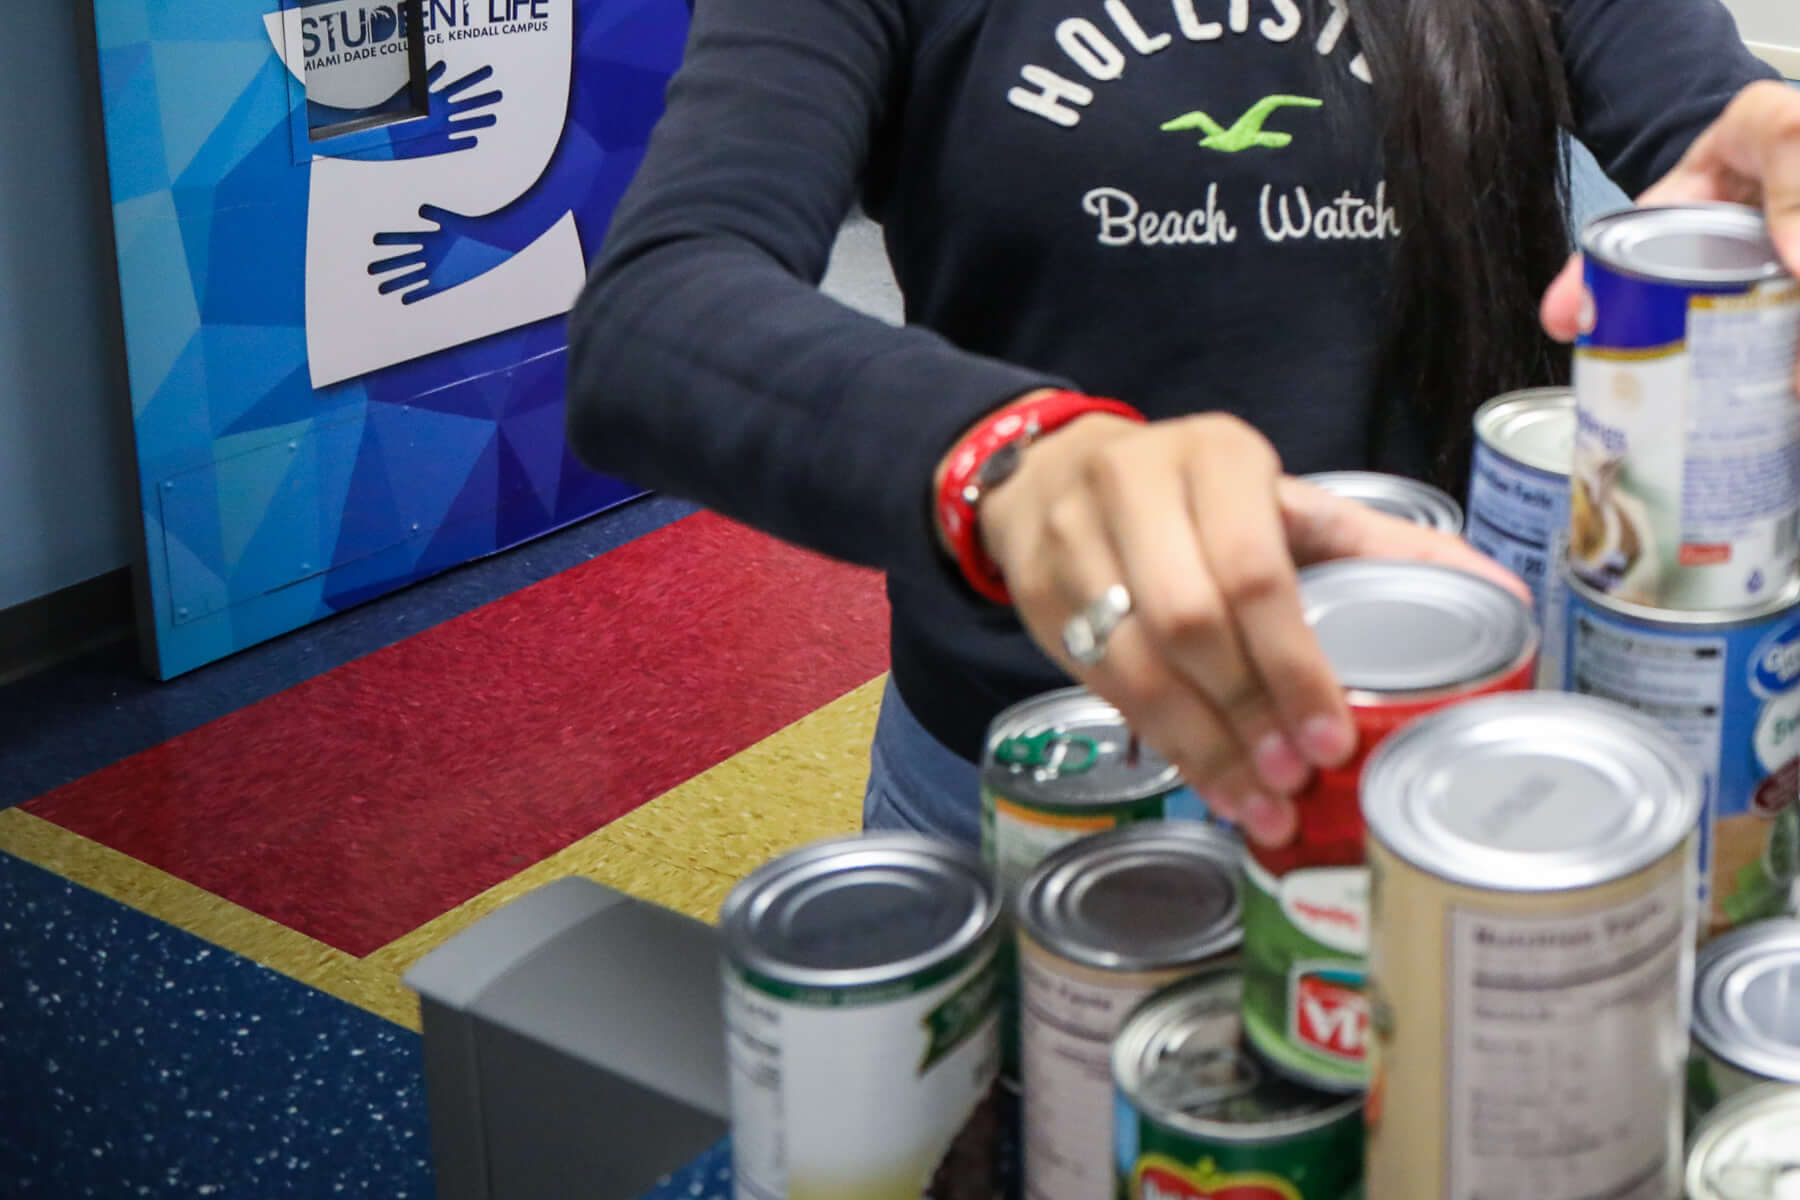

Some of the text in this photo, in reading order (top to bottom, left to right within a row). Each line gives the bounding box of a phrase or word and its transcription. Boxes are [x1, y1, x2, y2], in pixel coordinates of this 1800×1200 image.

[343, 46, 377, 64] DADE
[379, 33, 445, 56] COLLGE,
[448, 25, 500, 43] KENDALL
[501, 21, 549, 35] CAMPUS
[1082, 180, 1401, 246] Beach Watch
